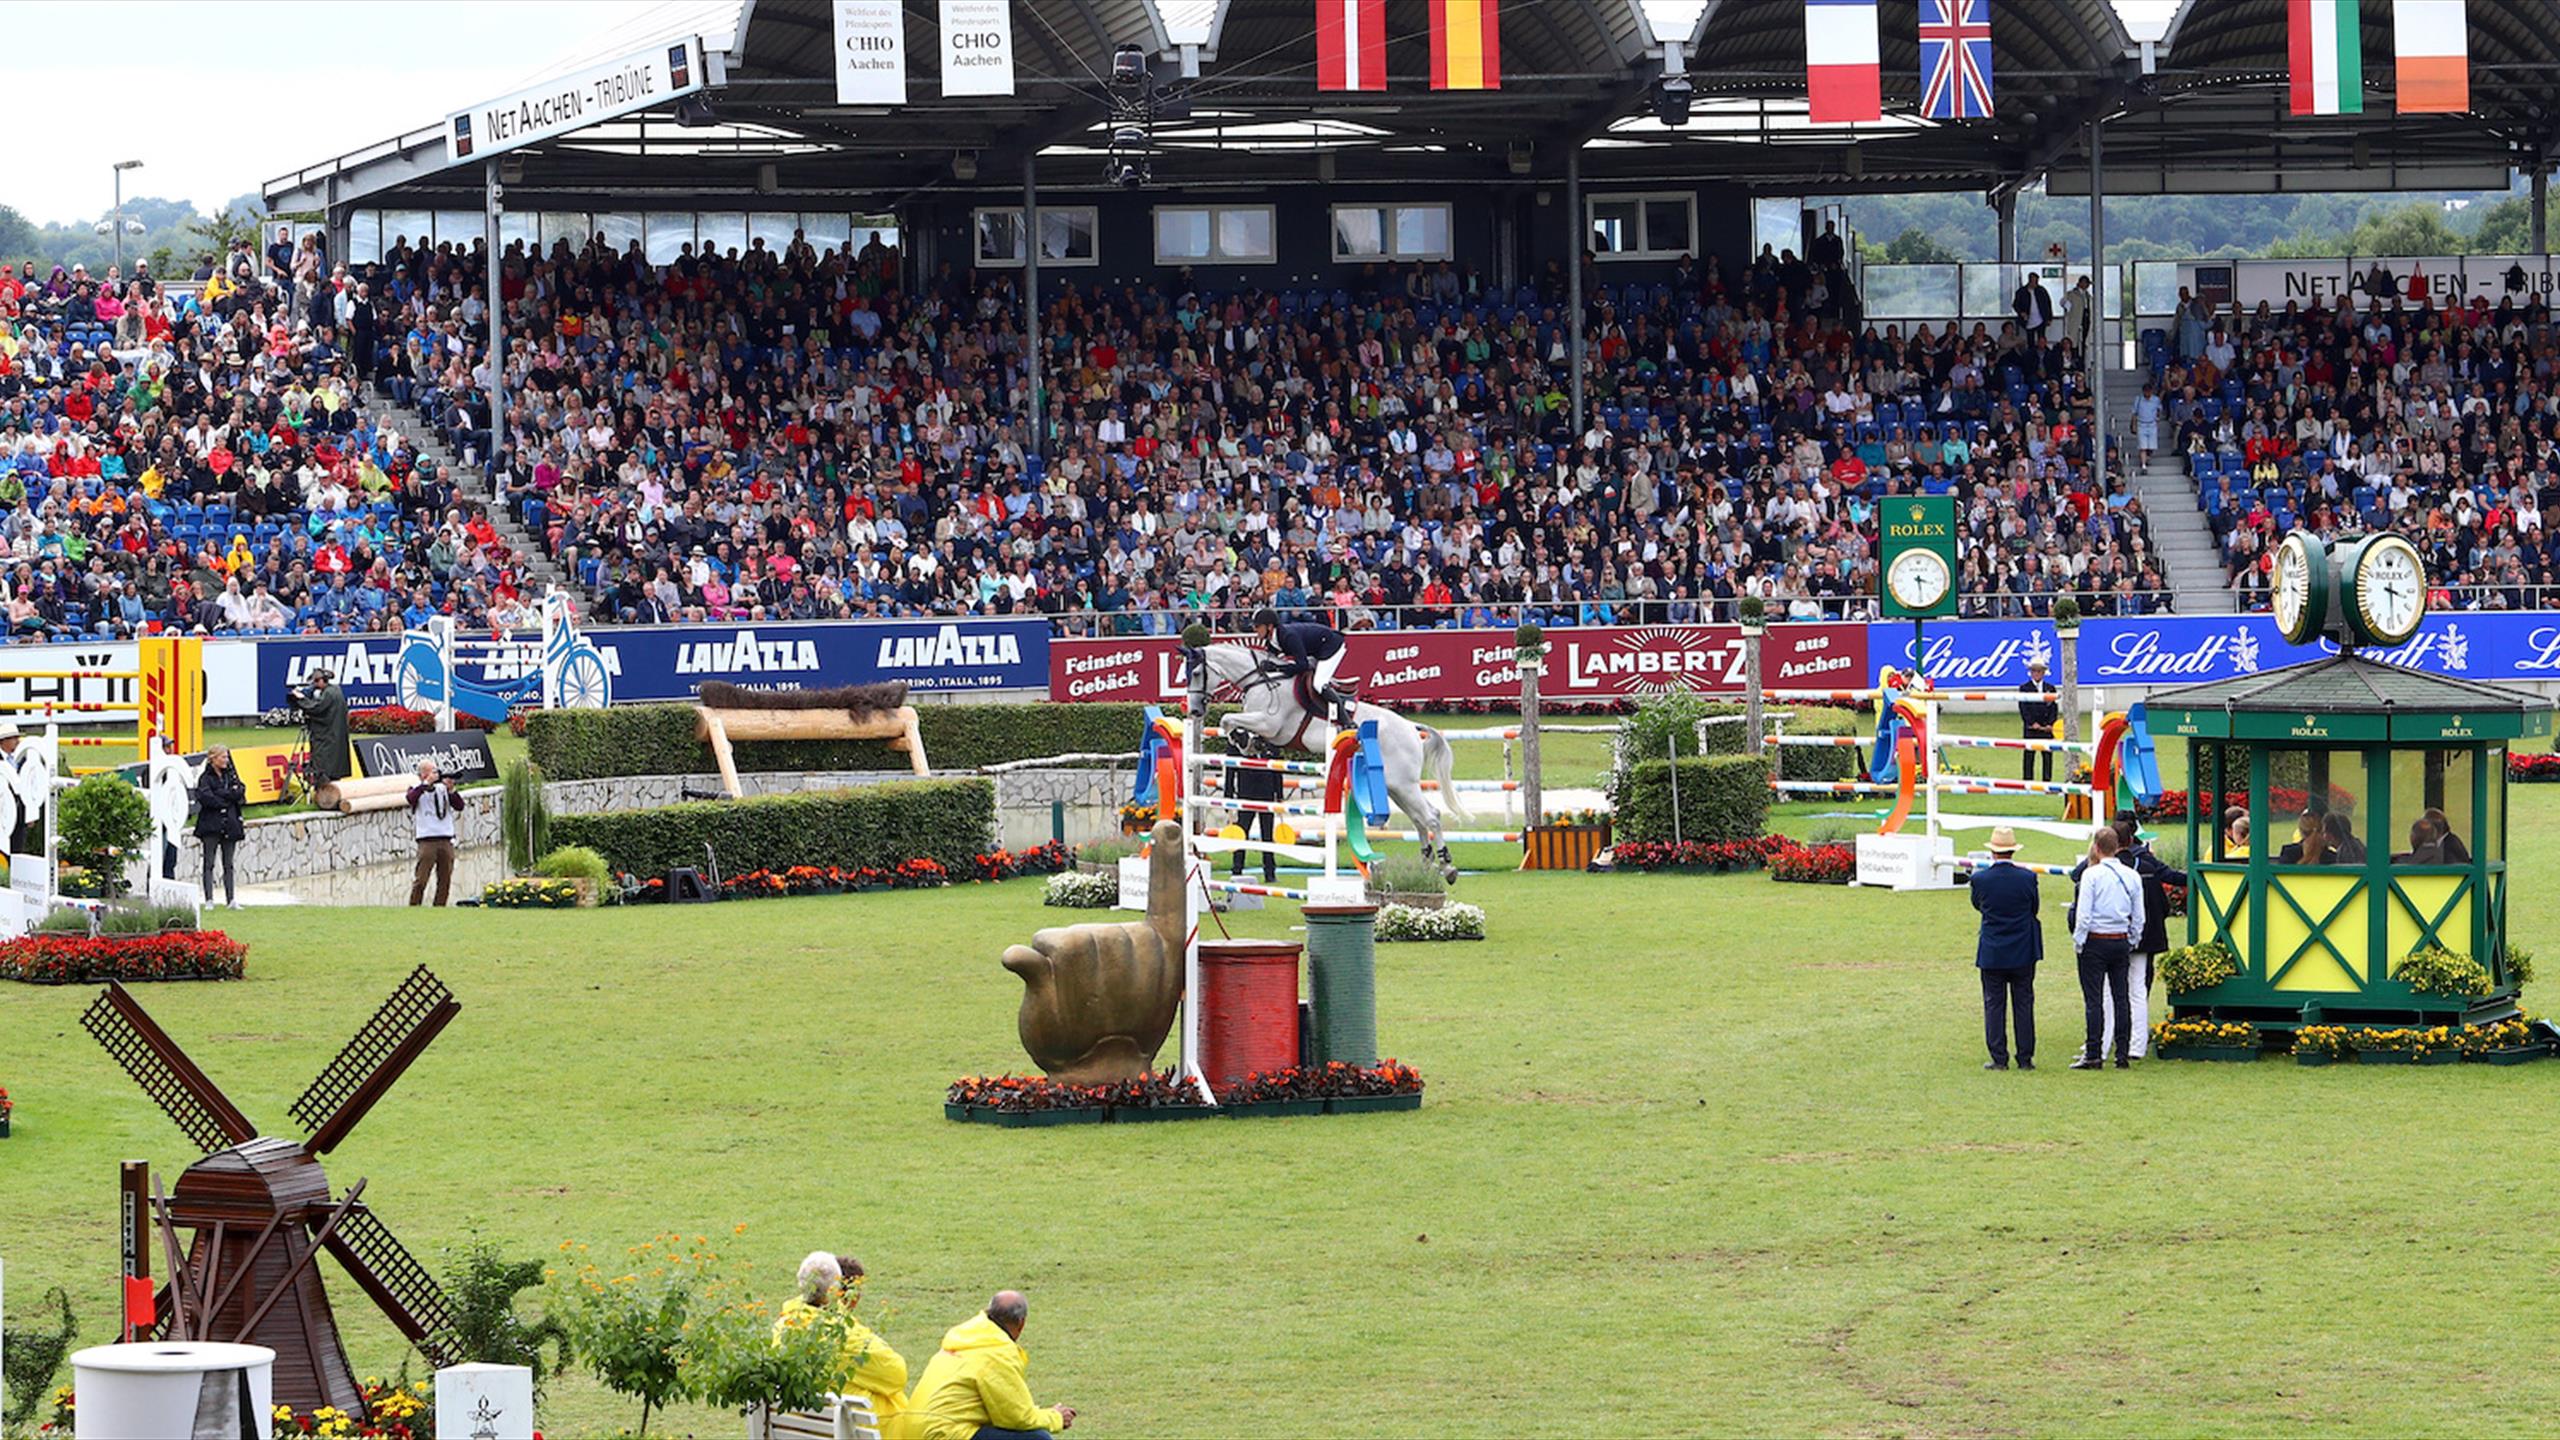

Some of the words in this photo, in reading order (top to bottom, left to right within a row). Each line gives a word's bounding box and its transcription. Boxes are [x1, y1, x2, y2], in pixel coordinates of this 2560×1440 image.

[846, 36, 894, 51] CHIO
[952, 32, 1001, 49] CHIO
[848, 58, 895, 70] Aachen
[953, 54, 1002, 66] Aachen
[595, 65, 654, 110] TRIBÜNE
[1890, 524, 1945, 537] ROLEX
[2375, 571, 2403, 580] ROLEX
[675, 631, 821, 674] LAVAZZA
[877, 625, 1021, 668] LAVAZZA
[1794, 636, 1829, 652] aus
[2097, 630, 2228, 675] Lindt
[1385, 645, 1420, 662] aus
[1905, 635, 2021, 679] Lindt
[1065, 650, 1144, 676] Feinstes
[1568, 639, 1747, 688] LAMBERTZ
[1779, 654, 1851, 678] Aachen
[1069, 670, 1140, 697] Gebäck
[1369, 665, 1441, 688] Aachen
[2177, 725, 2198, 733] ROLEX
[2292, 728, 2327, 736] ROLEX
[2441, 728, 2473, 737] ROLEX
